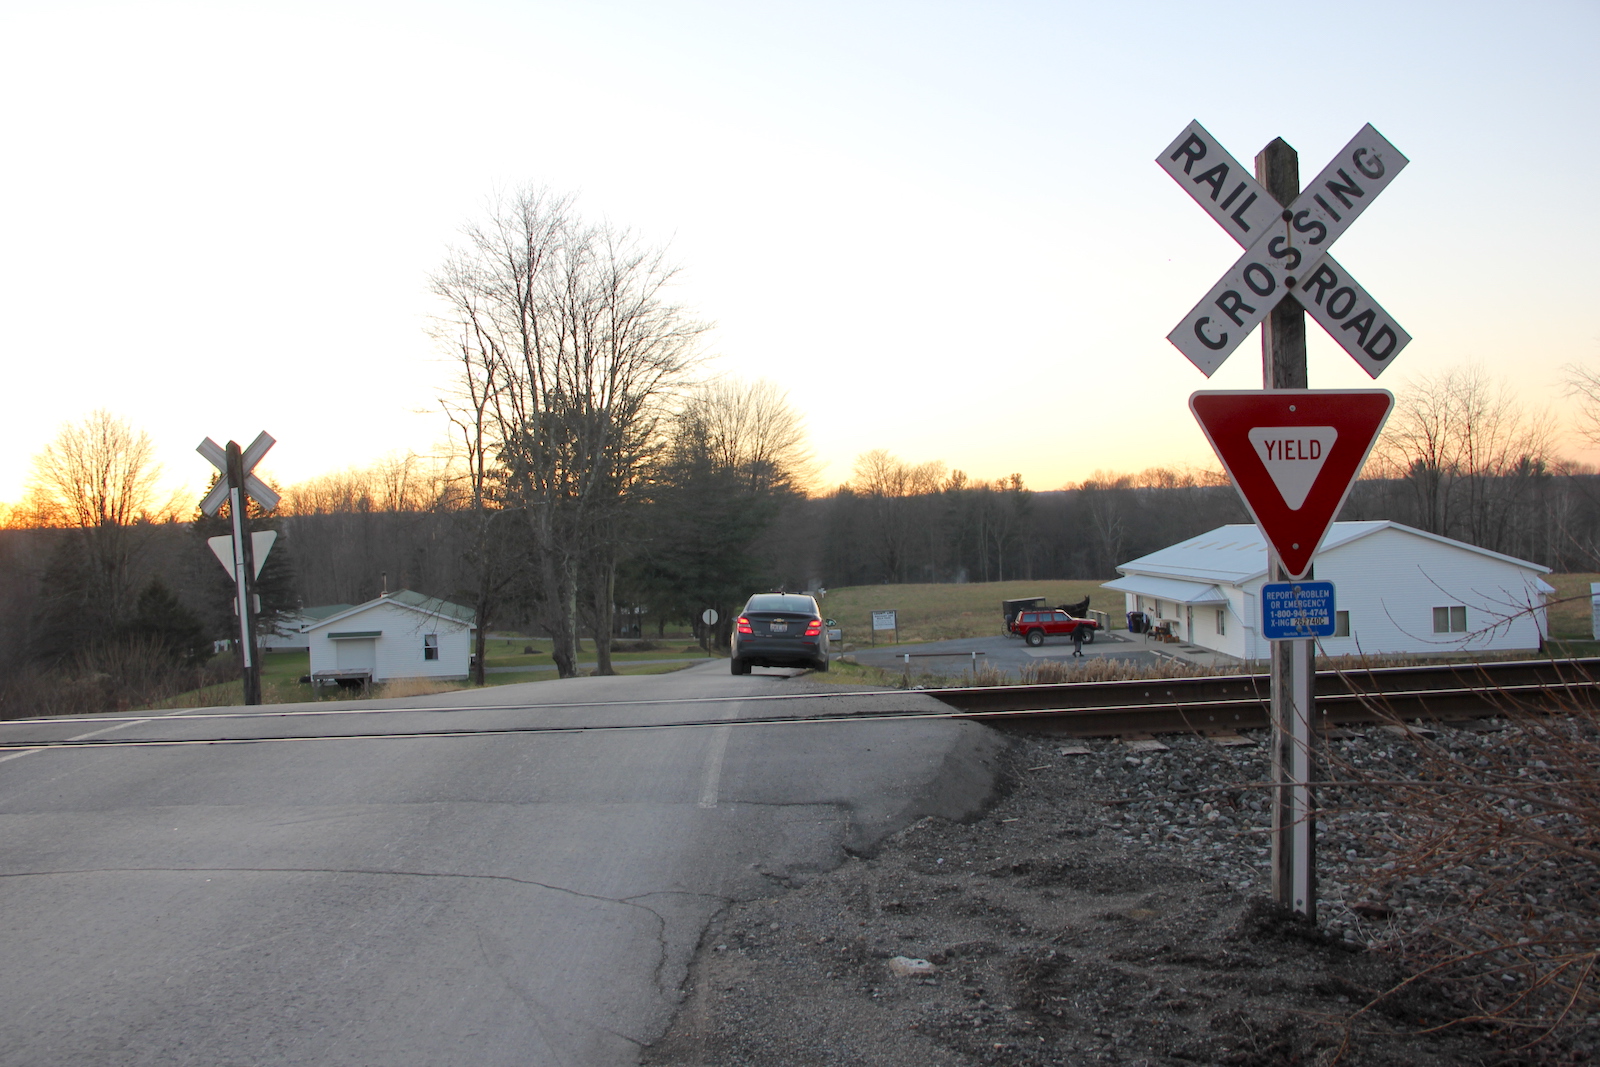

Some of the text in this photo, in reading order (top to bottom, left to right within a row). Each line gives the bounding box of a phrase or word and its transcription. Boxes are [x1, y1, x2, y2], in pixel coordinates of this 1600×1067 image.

[1170, 132, 1398, 361] RAIL ROAD
[1194, 147, 1385, 350] CROSSING
[1264, 439, 1321, 461] YIELD
[1266, 590, 1330, 600] REPORT PROBLEM
[1270, 599, 1326, 609] OR EMERGENCY
[1270, 608, 1328, 618] 1-800-946-4744
[1271, 618, 1290, 627] X-ING
